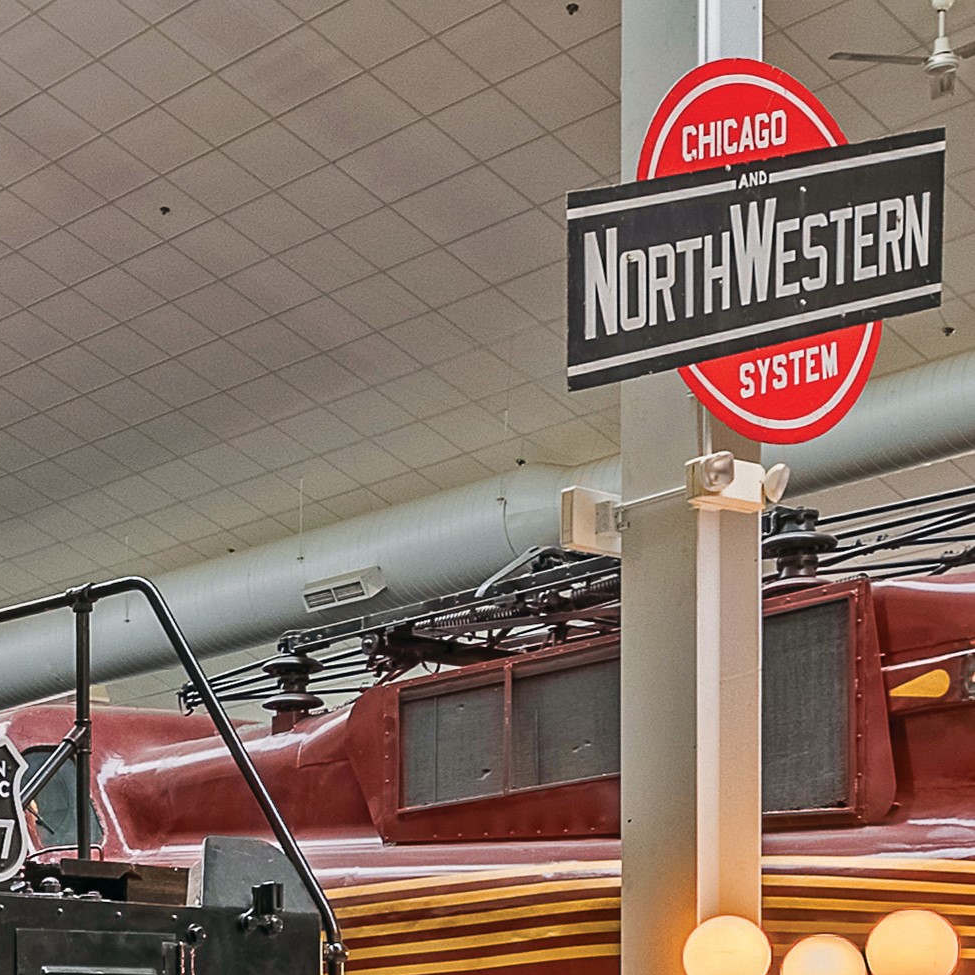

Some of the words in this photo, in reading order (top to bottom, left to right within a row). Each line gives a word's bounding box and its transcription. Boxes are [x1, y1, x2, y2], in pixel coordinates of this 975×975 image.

[682, 110, 787, 162] CHICAGO
[738, 170, 767, 189] AND
[739, 342, 839, 399] SYSTEM
